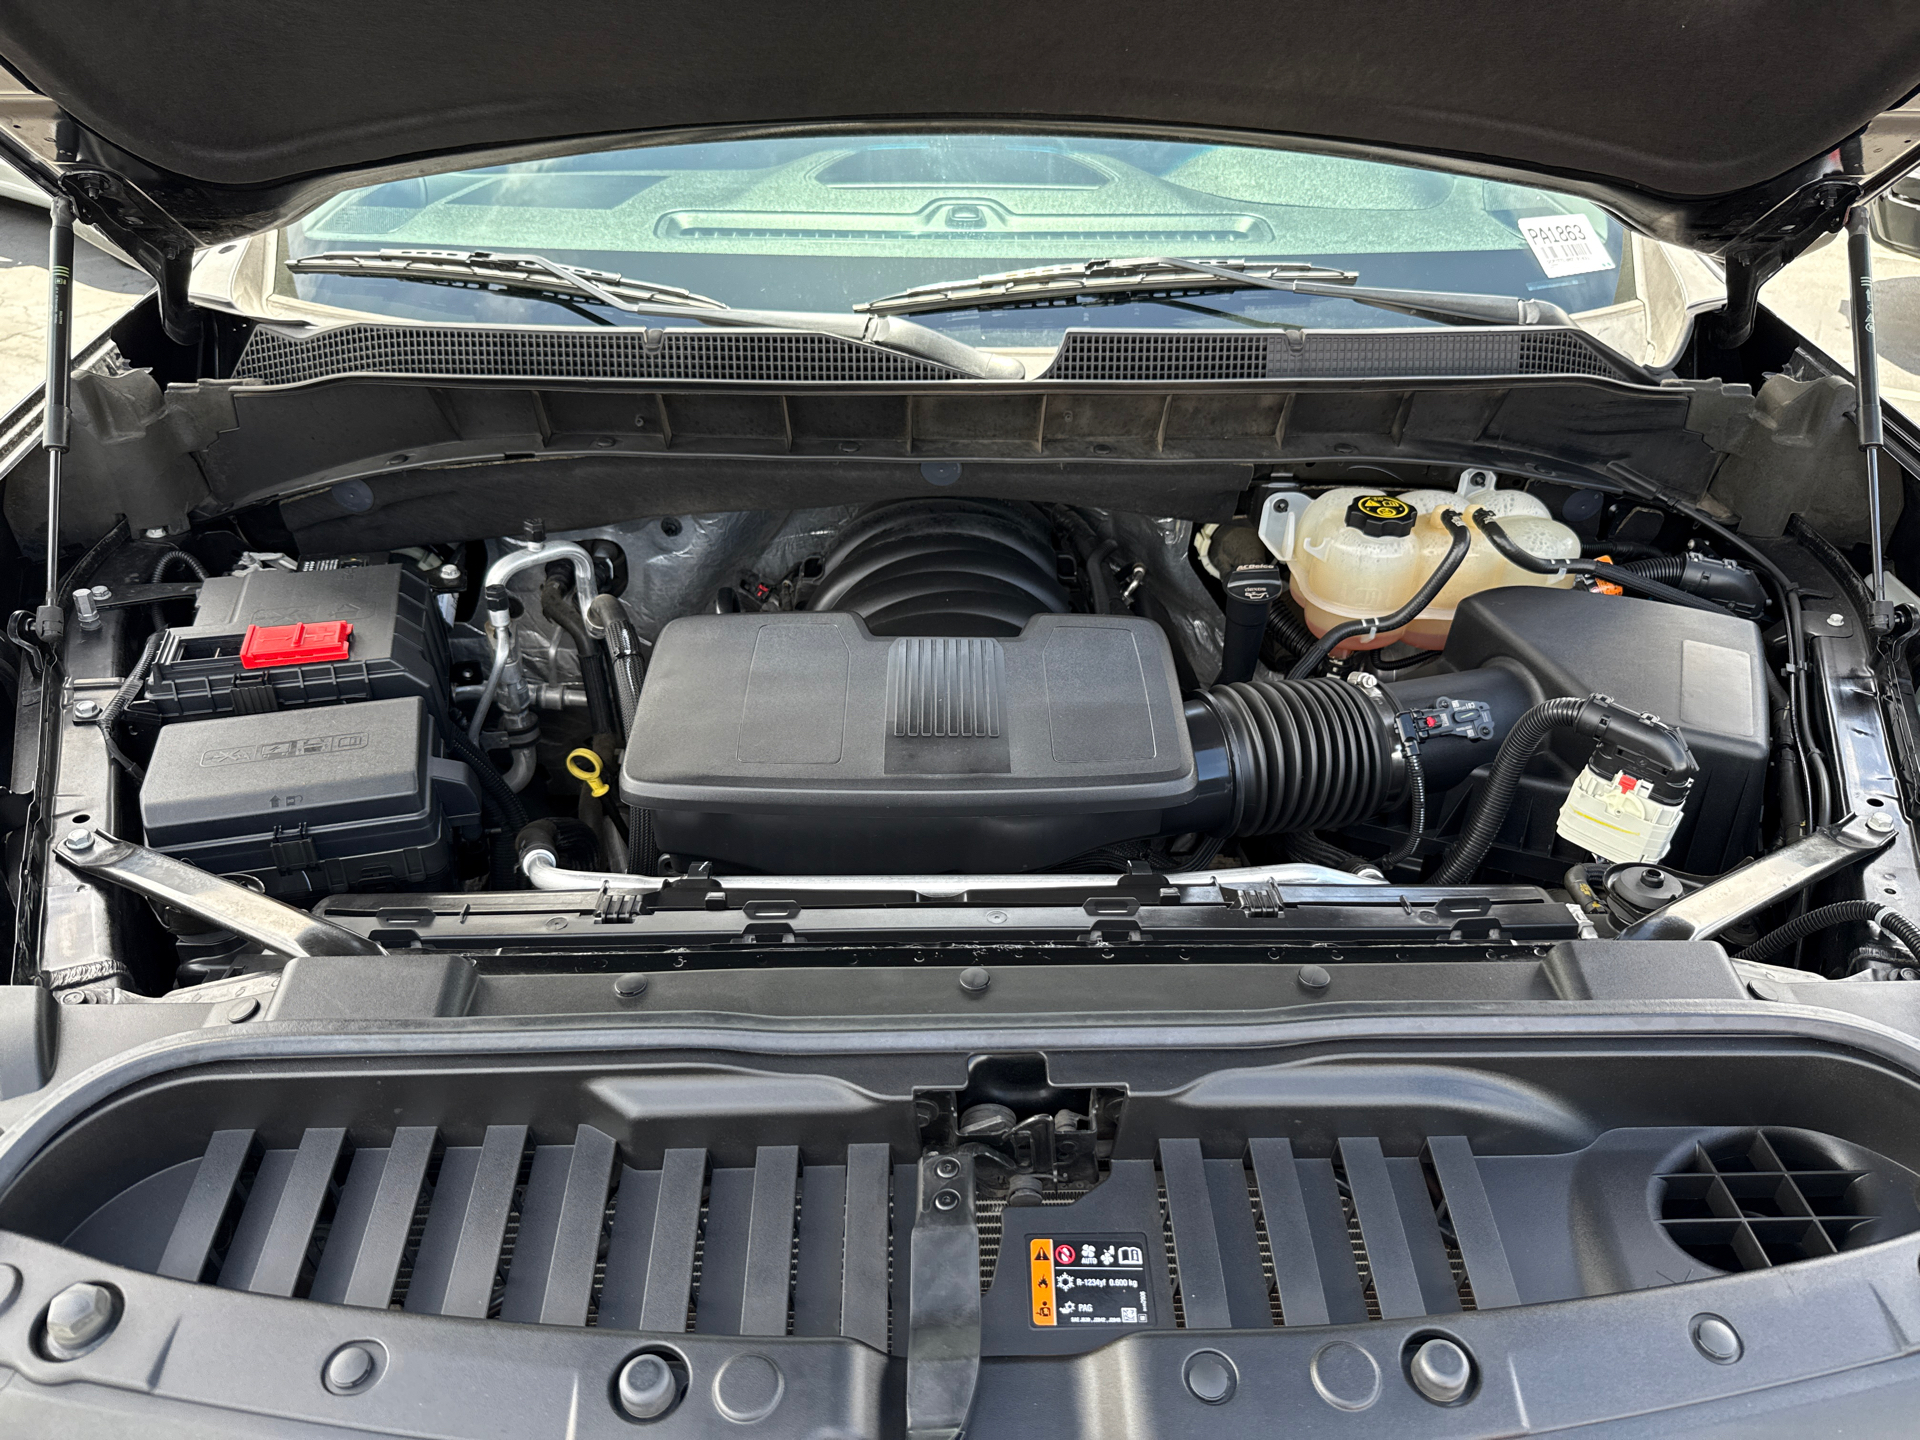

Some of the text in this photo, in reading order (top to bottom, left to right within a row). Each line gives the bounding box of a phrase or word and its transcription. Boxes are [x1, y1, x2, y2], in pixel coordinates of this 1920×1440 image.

[1527, 224, 1586, 245] PA1863
[1236, 563, 1274, 571] ACDelco
[1076, 1278, 1106, 1288] R-1234yf
[1128, 1279, 1138, 1288] kg
[1078, 1303, 1093, 1312] PAG
